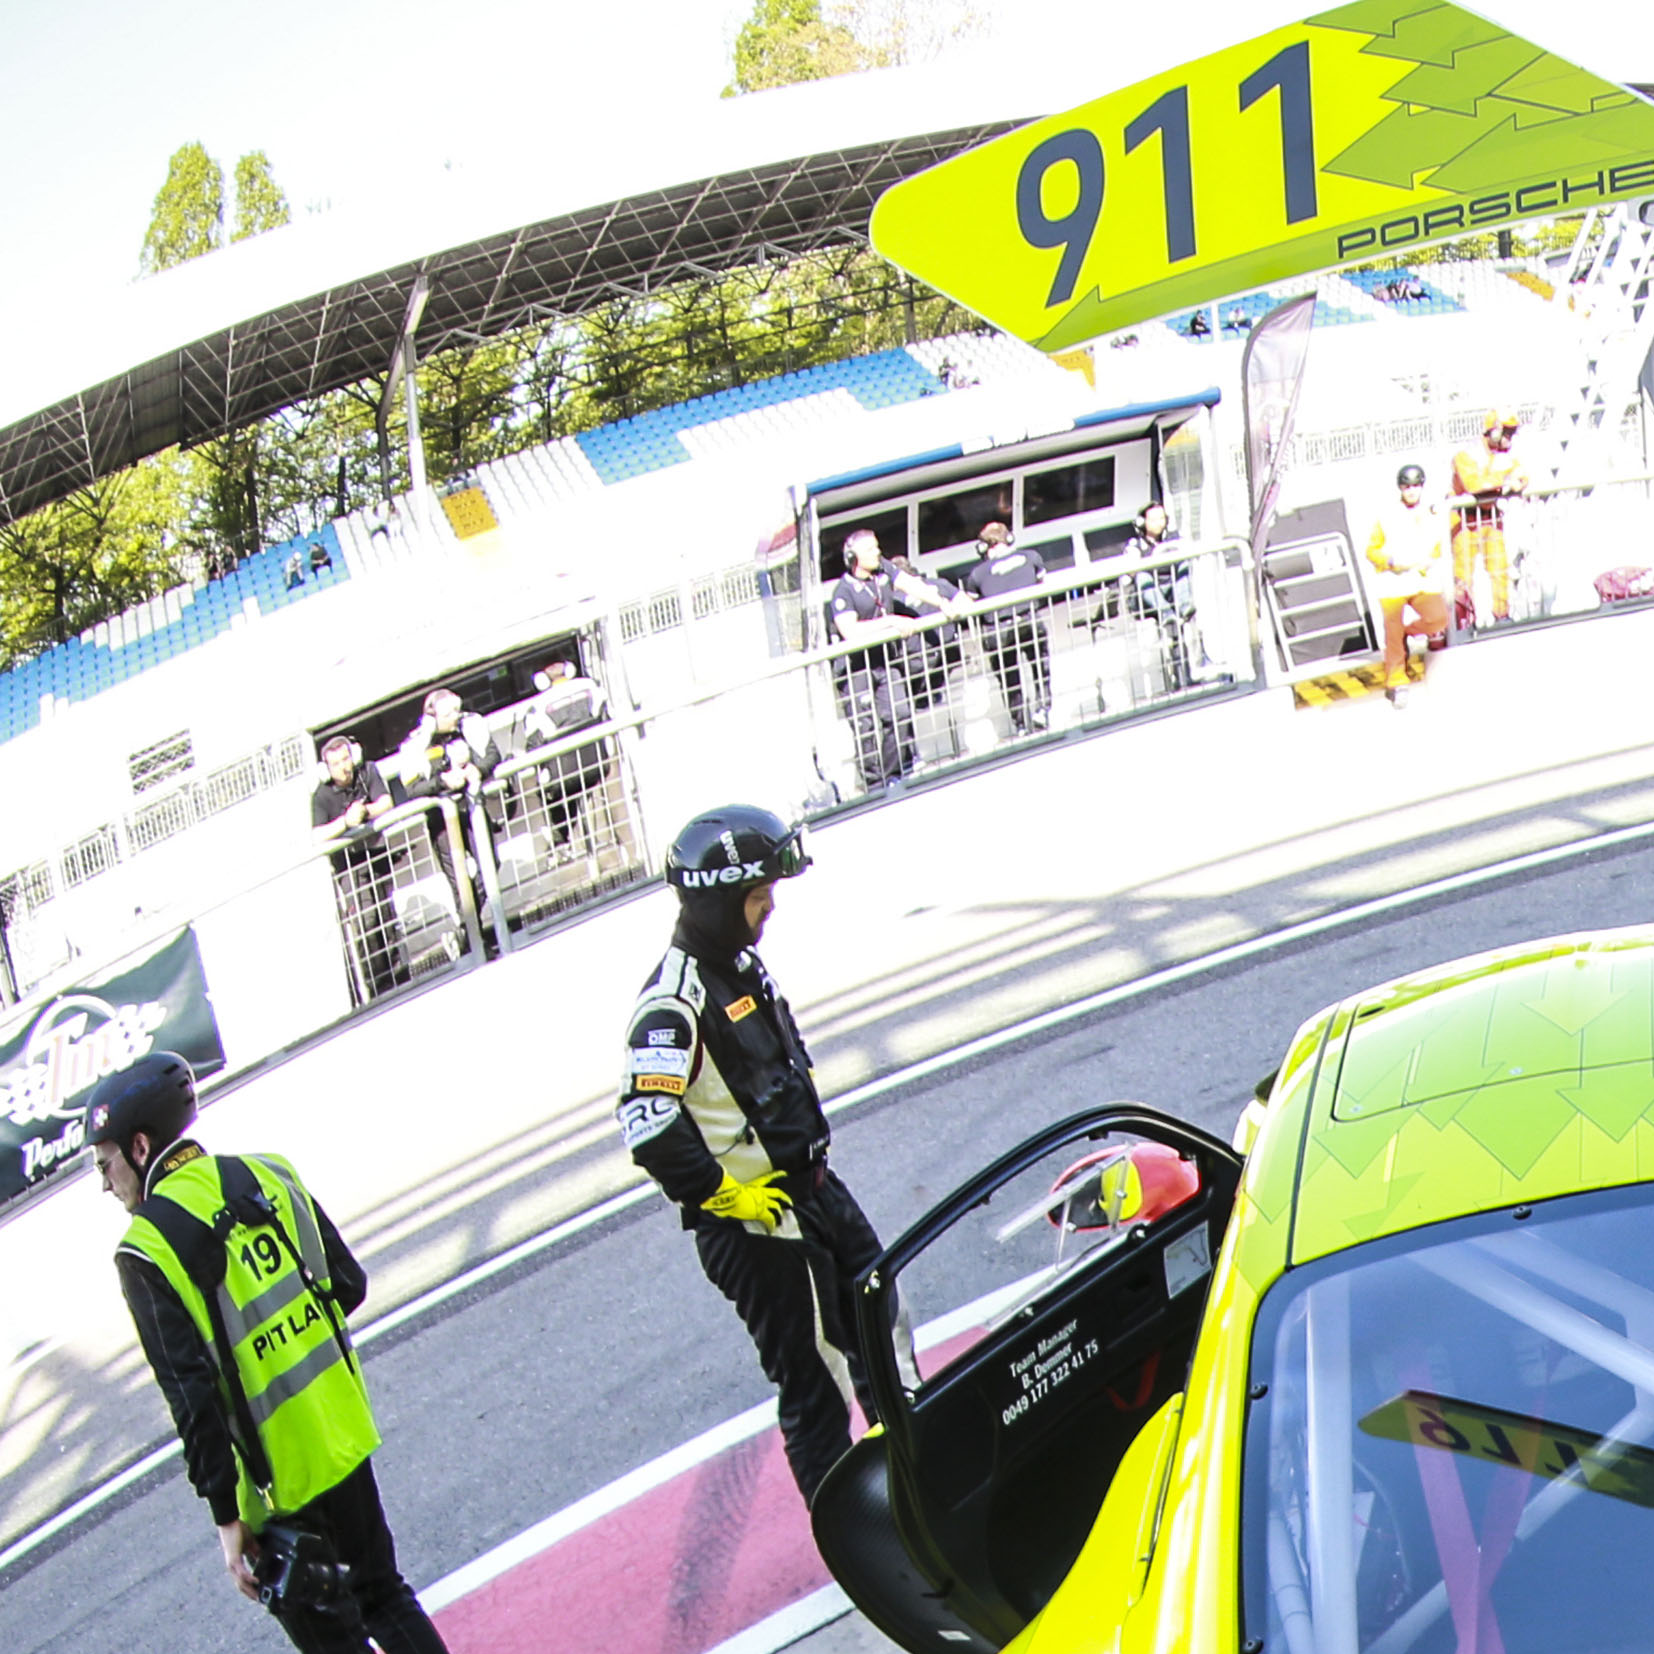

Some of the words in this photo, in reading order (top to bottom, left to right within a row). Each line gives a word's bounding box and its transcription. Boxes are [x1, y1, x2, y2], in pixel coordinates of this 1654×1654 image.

[1015, 39, 1318, 309] 911
[682, 860, 766, 888] uvex
[240, 1233, 282, 1282] 19
[252, 1322, 289, 1361] PIT
[289, 1302, 321, 1337] LA
[1009, 1351, 1037, 1378] Team
[1037, 1318, 1078, 1357] Manager
[1002, 1394, 1029, 1425] 0049
[1030, 1378, 1049, 1403] 177
[1050, 1361, 1071, 1387] 322
[1071, 1351, 1085, 1369] 41
[1084, 1338, 1099, 1359] 75
